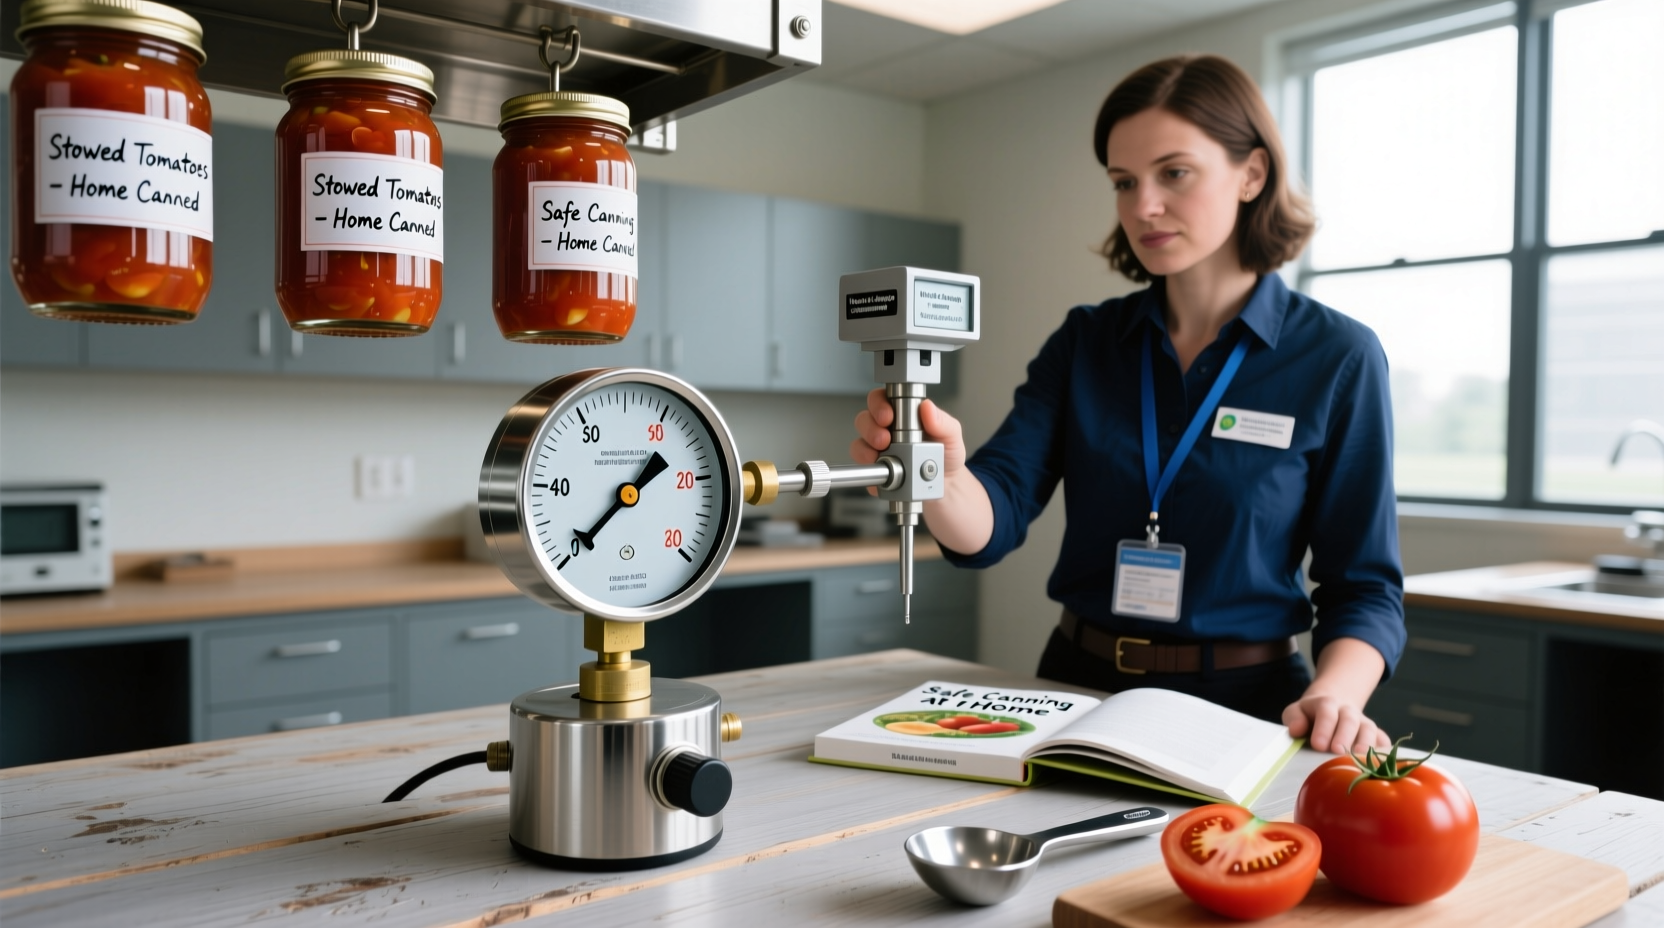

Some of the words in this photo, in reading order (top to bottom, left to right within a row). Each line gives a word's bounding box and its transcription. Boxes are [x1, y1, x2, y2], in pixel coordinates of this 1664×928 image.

[49, 133, 126, 163] Stowed
[70, 173, 129, 200] Home
[137, 180, 200, 212] Canned
[312, 173, 380, 198] Stowed
[333, 207, 383, 230] Home
[389, 211, 436, 238] Canned
[541, 199, 581, 229] Safe
[557, 231, 598, 252] Home
[549, 477, 571, 497] 40
[676, 471, 695, 490] 20
[969, 701, 1050, 716] Home
[982, 692, 1074, 712] Canning
